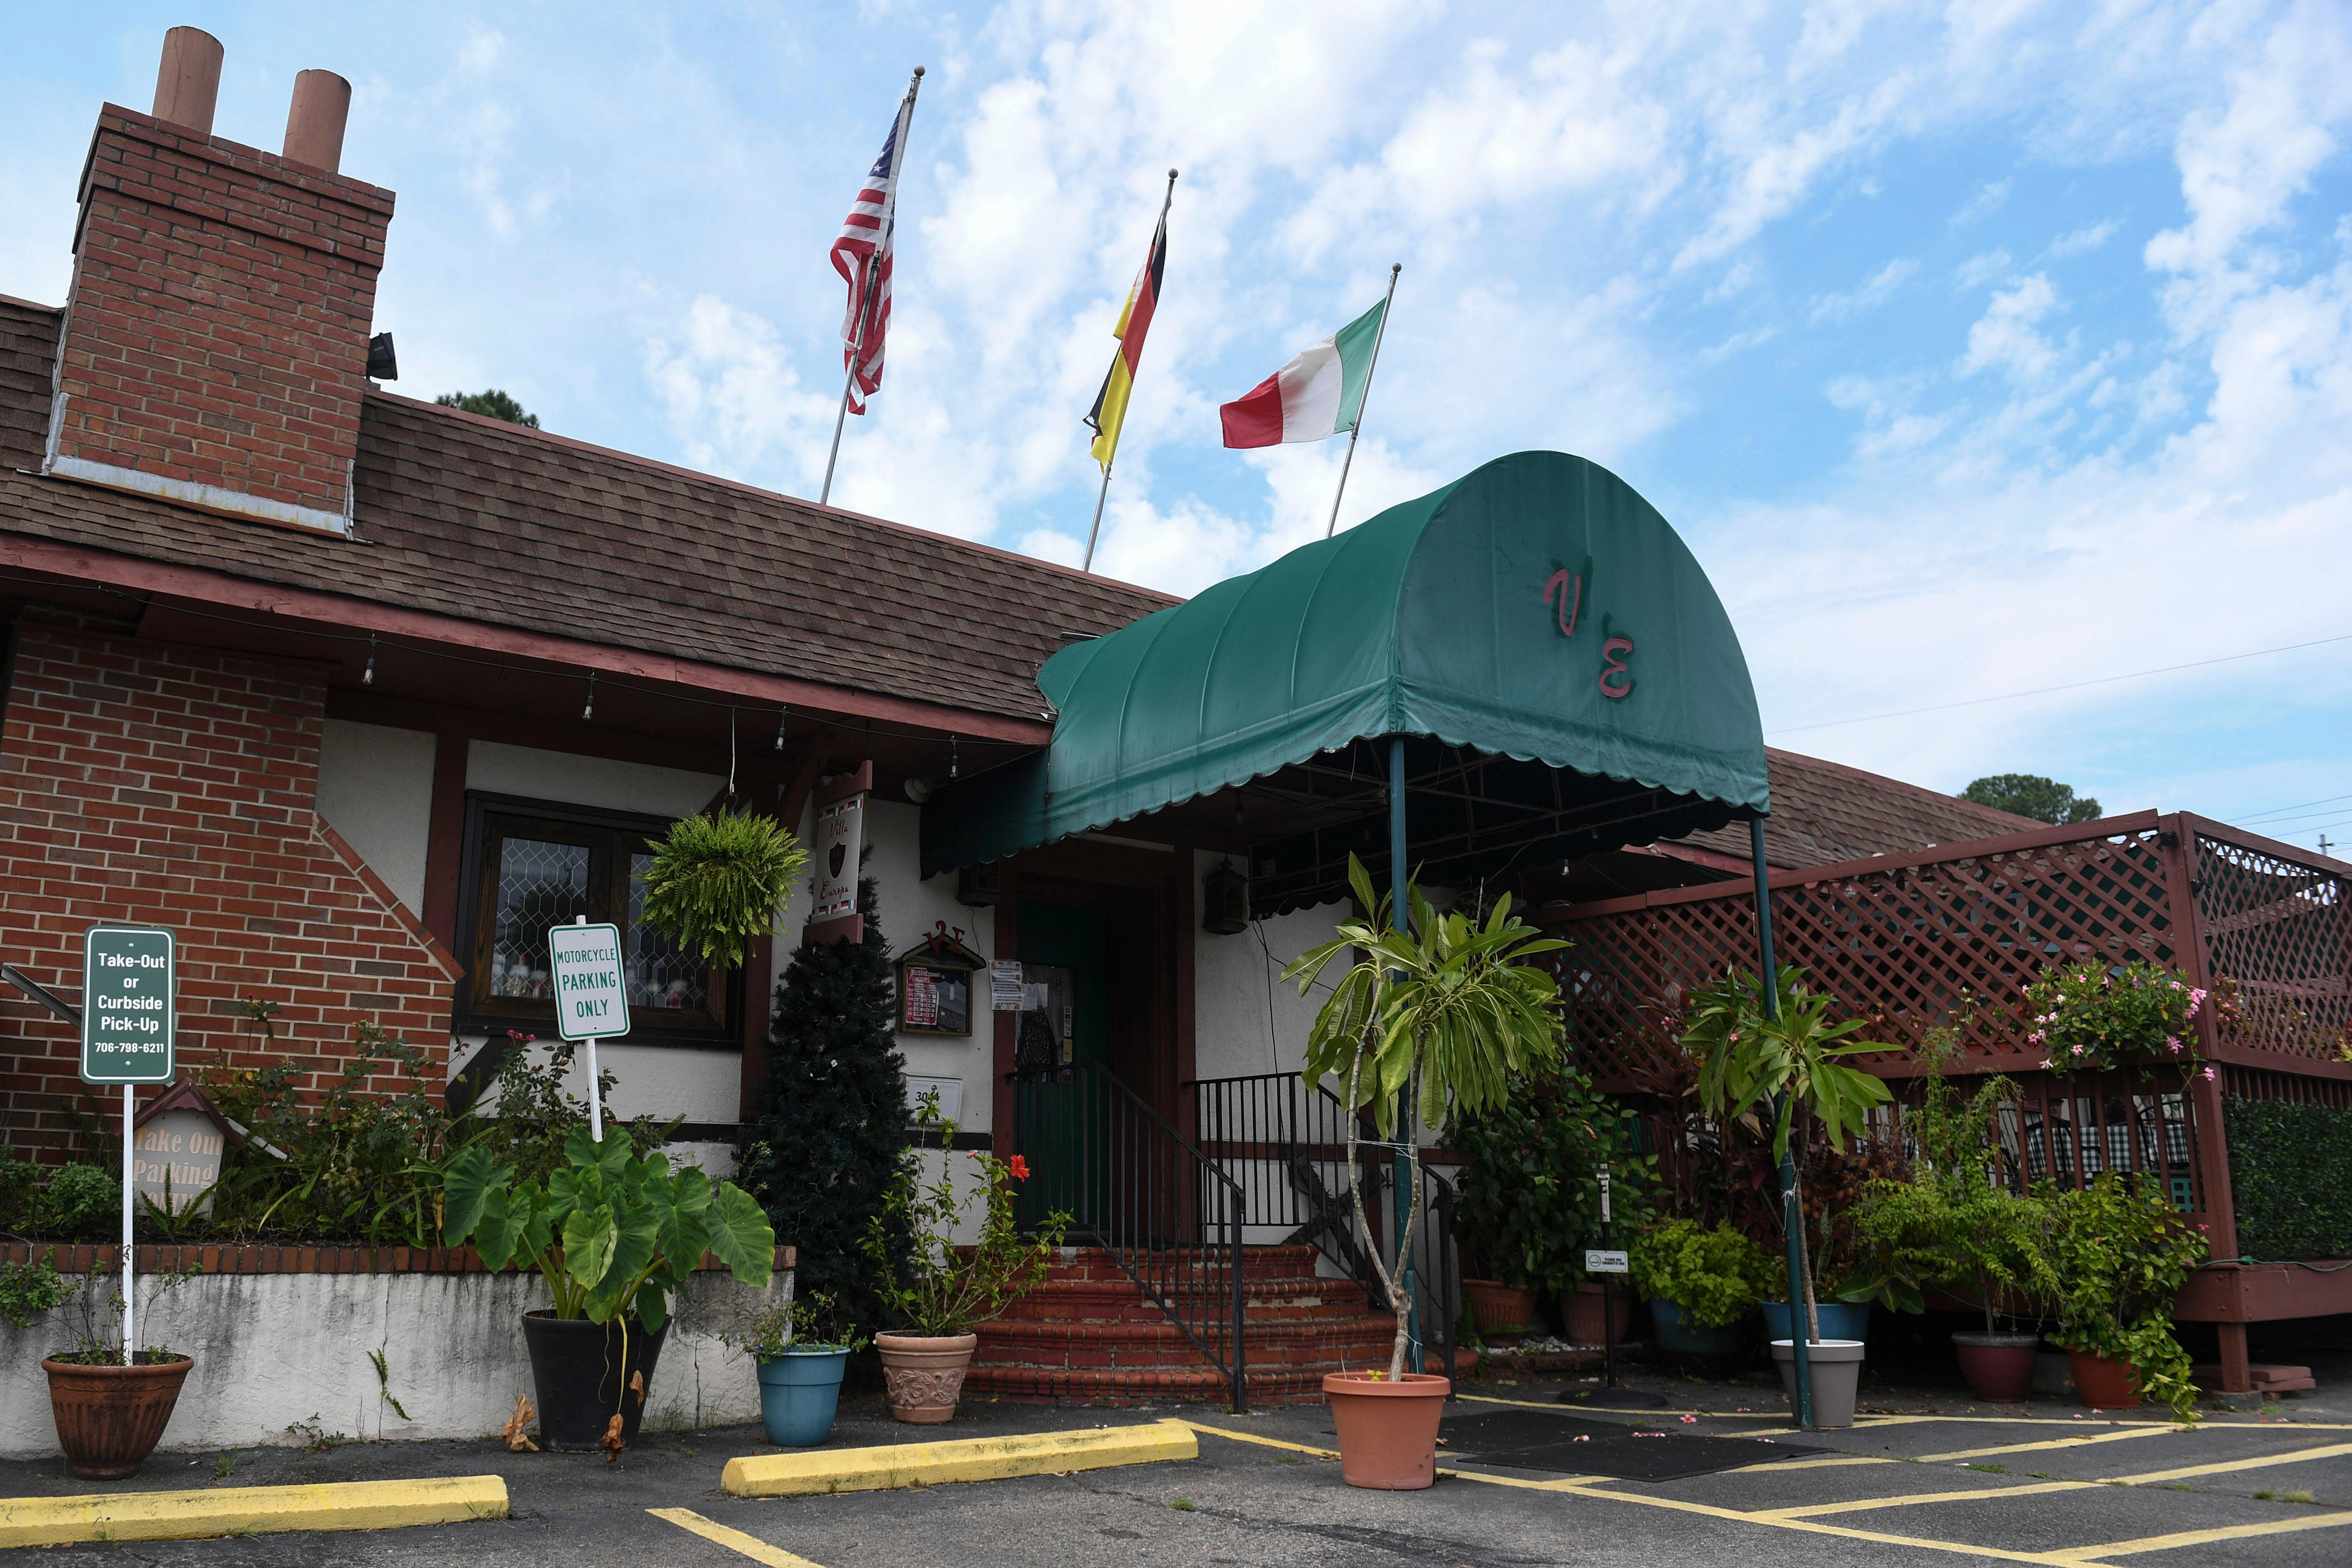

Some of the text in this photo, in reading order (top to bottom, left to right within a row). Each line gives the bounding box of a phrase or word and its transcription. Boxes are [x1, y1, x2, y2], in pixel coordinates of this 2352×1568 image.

[830, 819, 848, 837] Villa
[820, 878, 849, 900] Europa
[98, 953, 165, 969] Take-Out
[557, 948, 616, 964] MOTORCYCLE
[123, 977, 139, 988] or
[563, 971, 616, 991] PARKING
[98, 995, 163, 1010] Curbside
[577, 999, 608, 1018] ONLY
[101, 1016, 159, 1034] Pick-Up
[95, 1042, 164, 1053] 706-798-6211
[135, 1127, 225, 1155] Take Out
[132, 1159, 213, 1189] Parking
